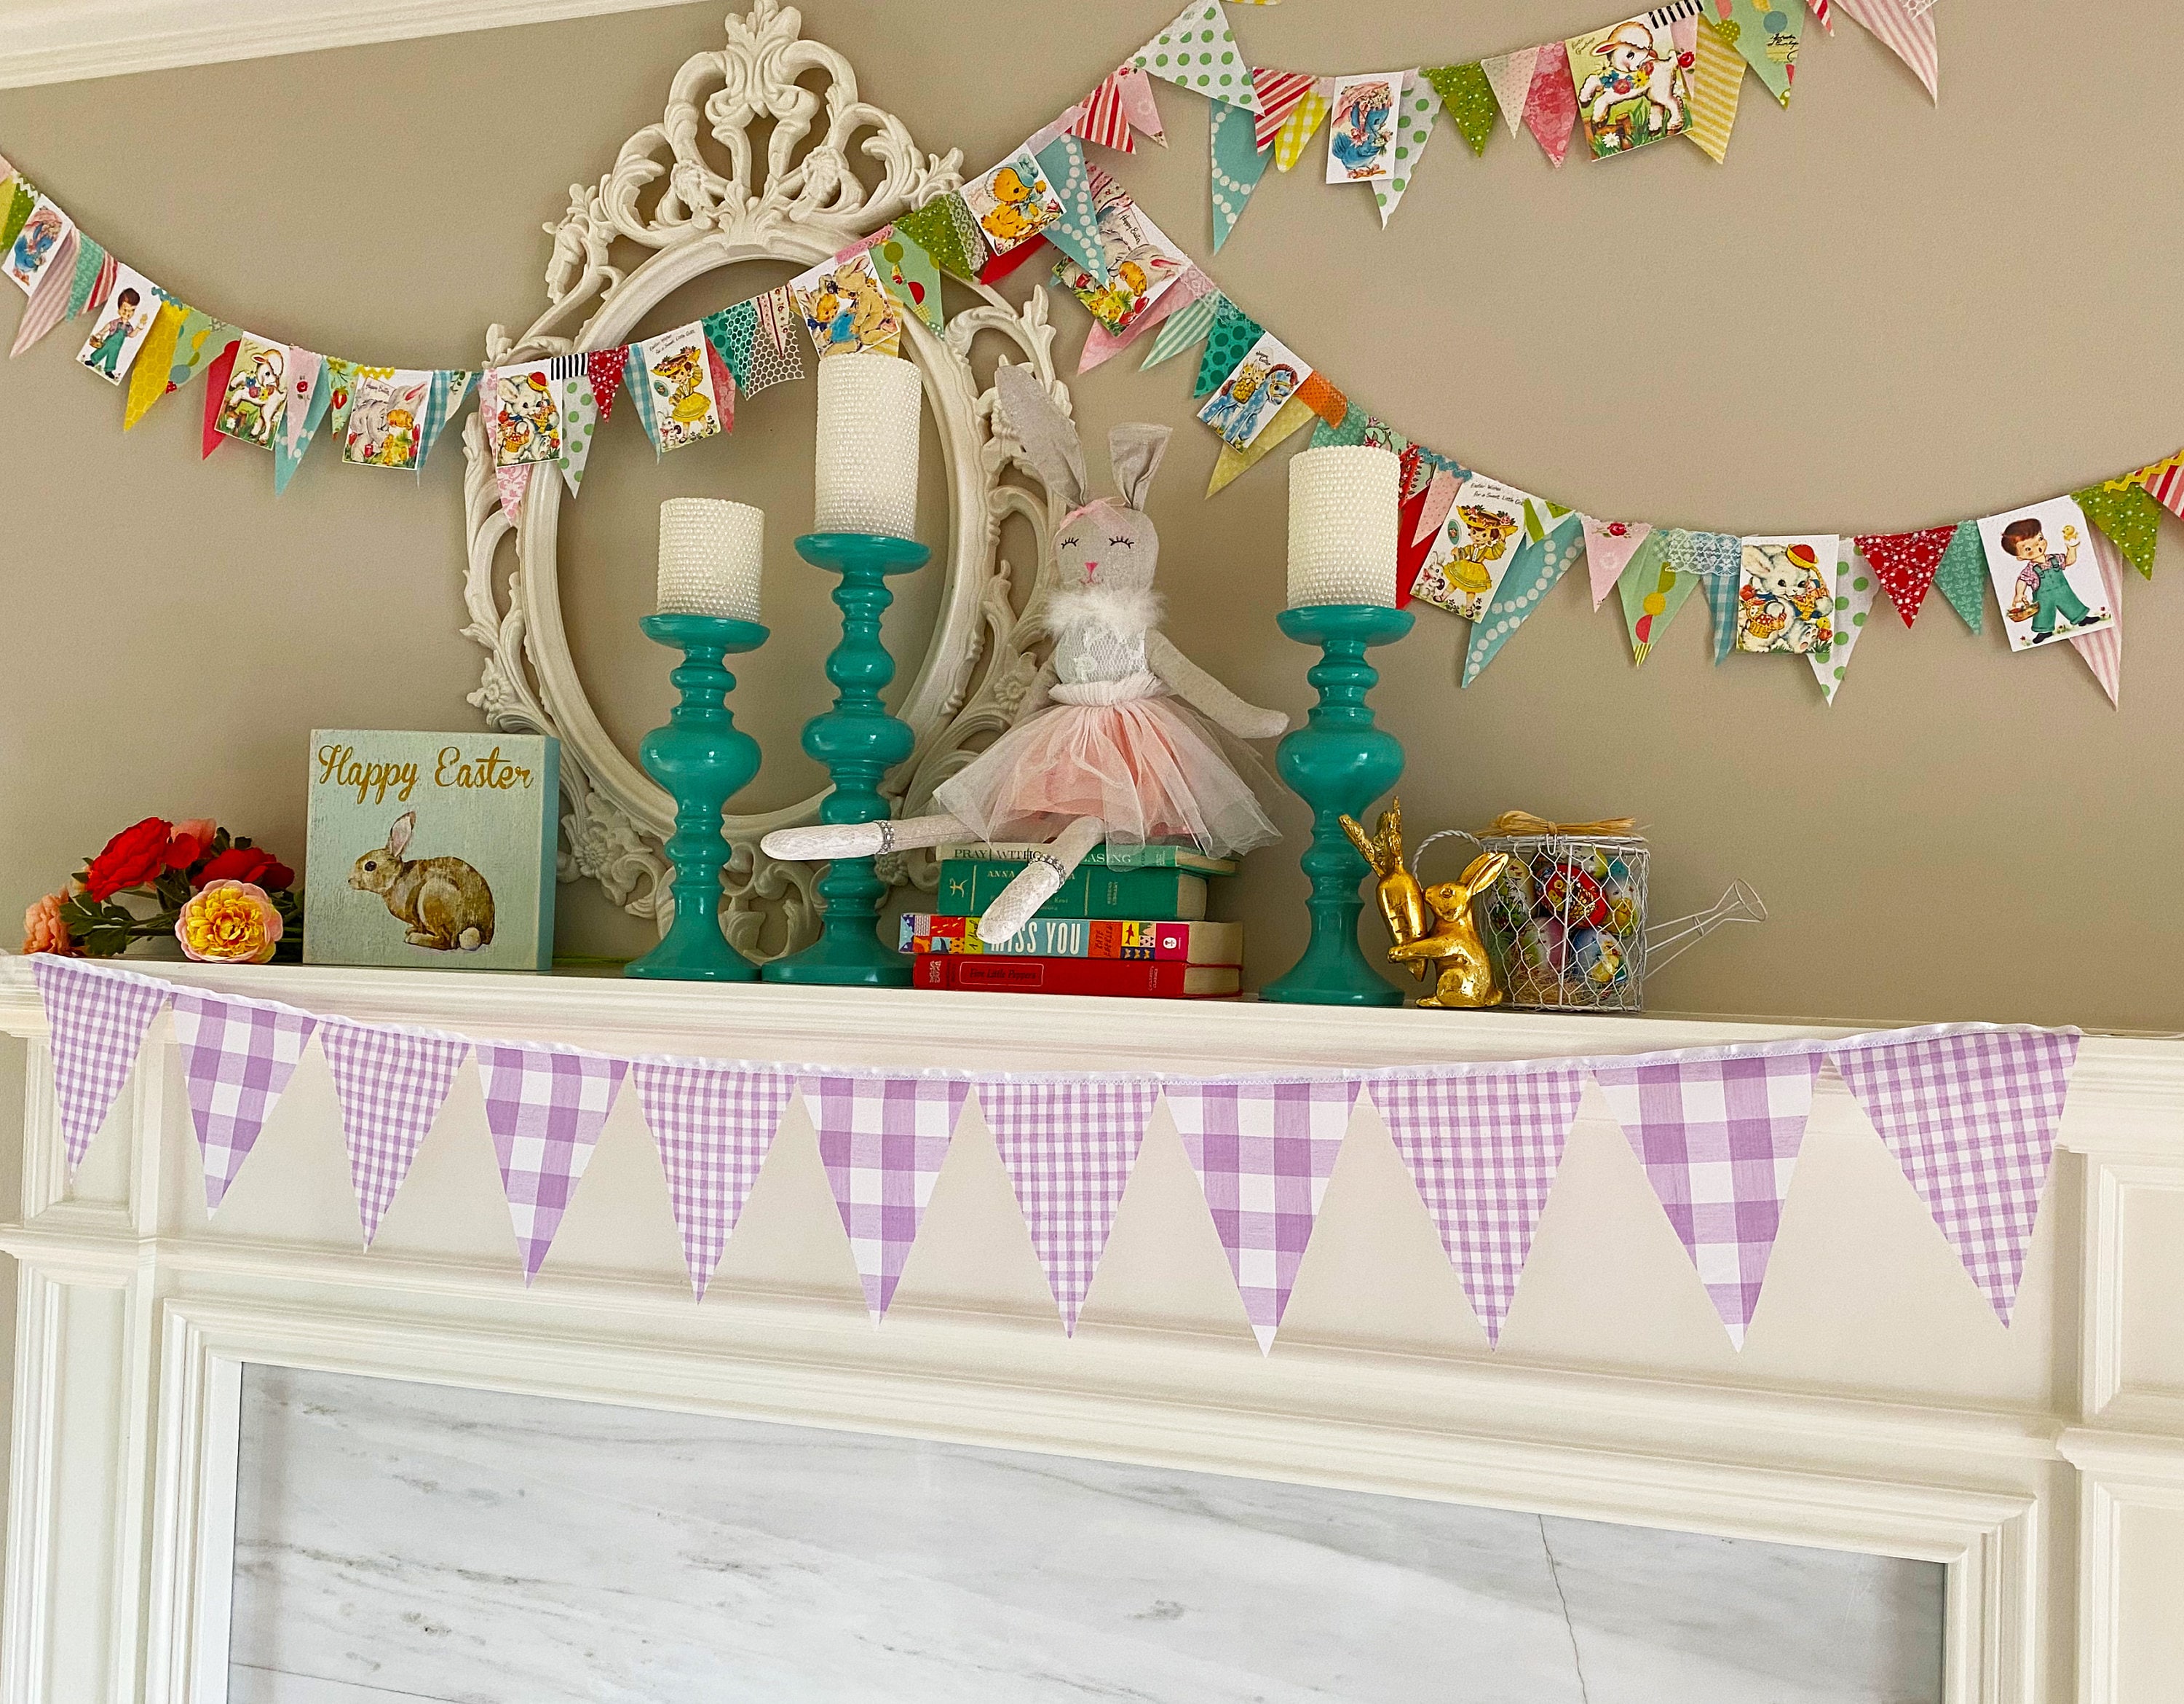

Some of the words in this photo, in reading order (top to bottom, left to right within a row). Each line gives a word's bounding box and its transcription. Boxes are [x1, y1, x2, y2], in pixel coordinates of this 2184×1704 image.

[318, 744, 418, 805] Happy
[435, 746, 534, 790] Easter
[954, 849, 988, 859] PRAY
[987, 870, 1015, 878] ANNA
[991, 921, 1038, 953] ISS
[1046, 922, 1081, 955] YOU
